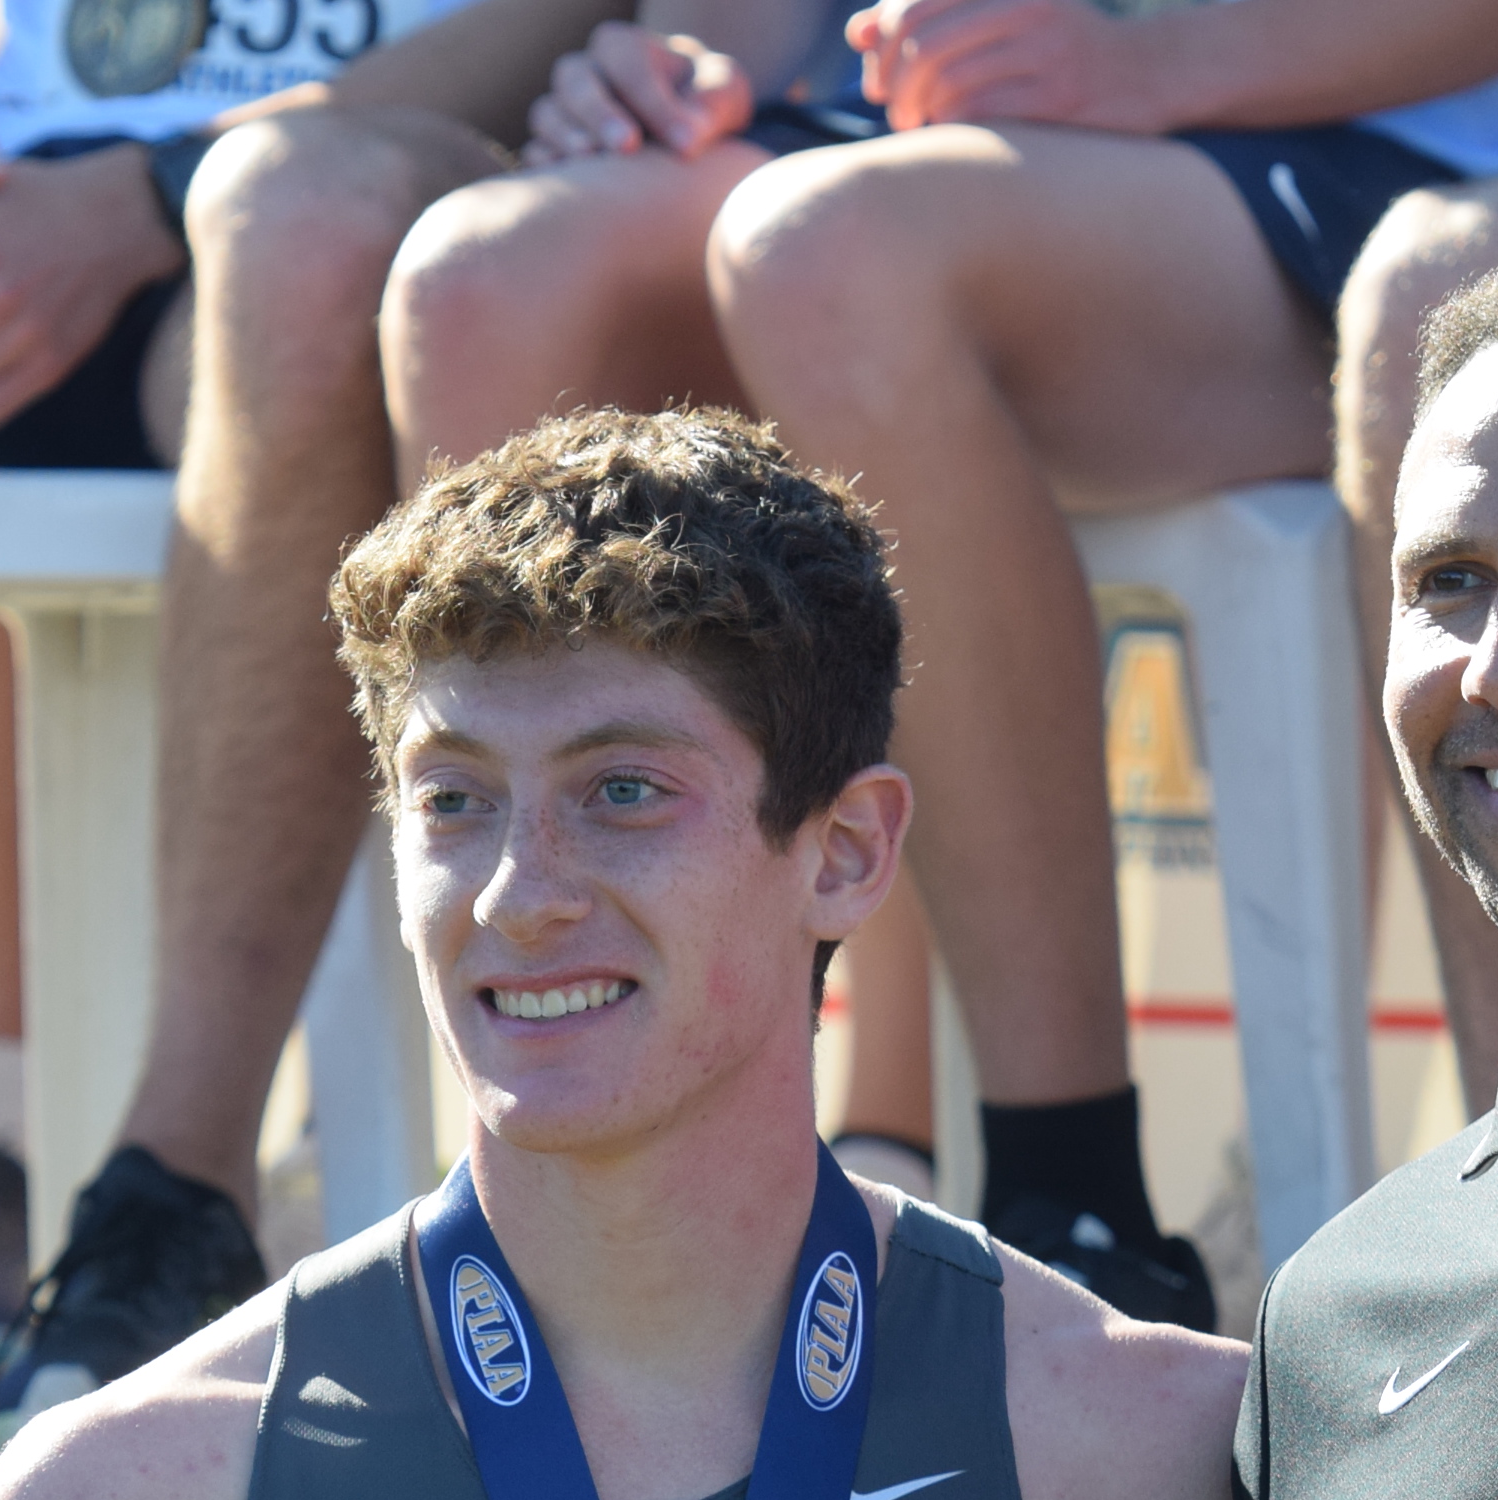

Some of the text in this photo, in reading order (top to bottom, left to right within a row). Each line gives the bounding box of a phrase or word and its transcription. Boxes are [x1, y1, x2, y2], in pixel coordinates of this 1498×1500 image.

[201, 0, 380, 60] 55
[458, 1274, 527, 1397] PIAA
[805, 1264, 856, 1391] PIAA
